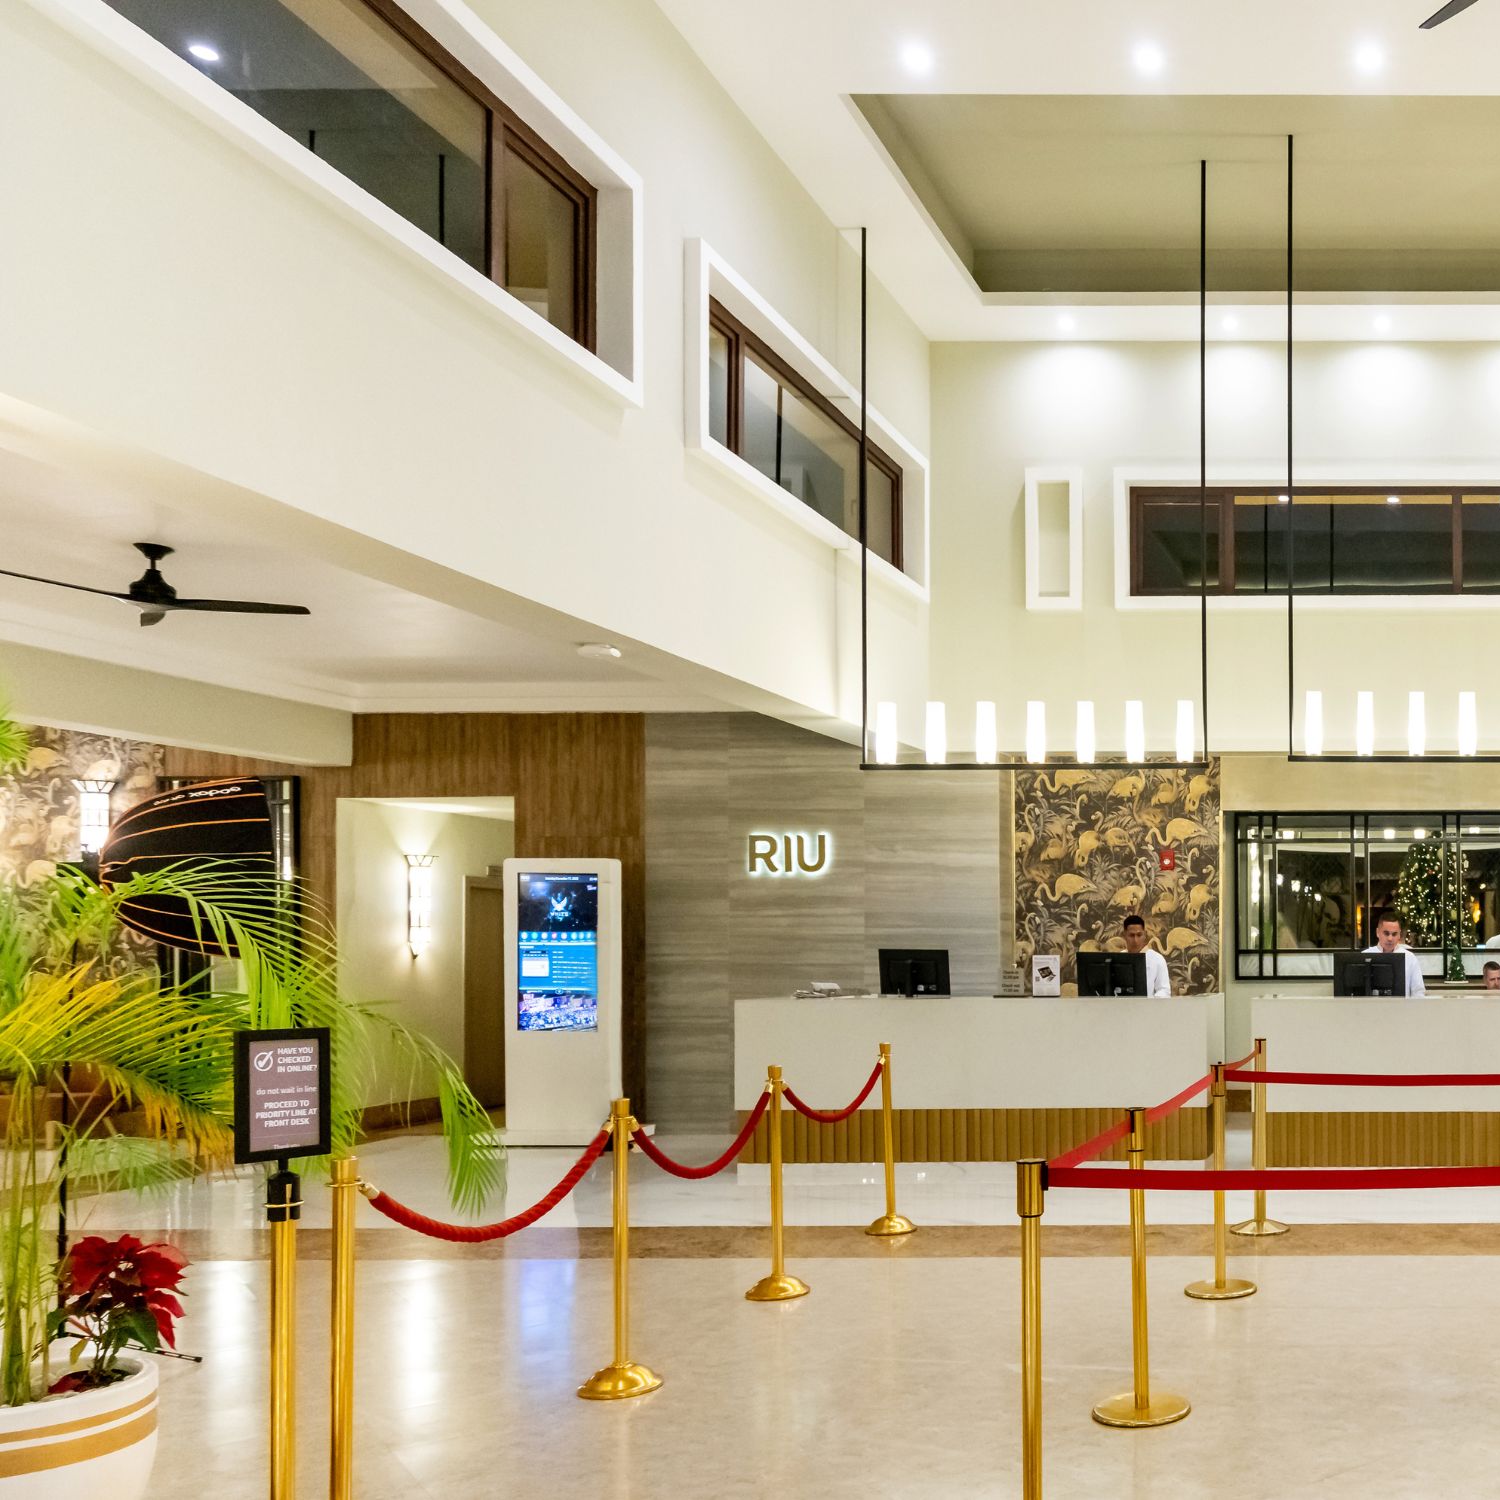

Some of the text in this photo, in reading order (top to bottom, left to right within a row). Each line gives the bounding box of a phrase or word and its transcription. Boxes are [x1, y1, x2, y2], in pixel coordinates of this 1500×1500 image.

[748, 834, 826, 873] RIU
[277, 1046, 313, 1055] HAVE YOU
[277, 1055, 311, 1064] CHECKED
[277, 1064, 318, 1073] IN ONLINE?
[280, 1086, 295, 1094] wait
[296, 1085, 303, 1093] in
[304, 1085, 318, 1093] line
[264, 1099, 310, 1109] PROCEED TO
[255, 1107, 318, 1119] PRIORITY LINE AT
[264, 1117, 310, 1128] FRONT DESK
